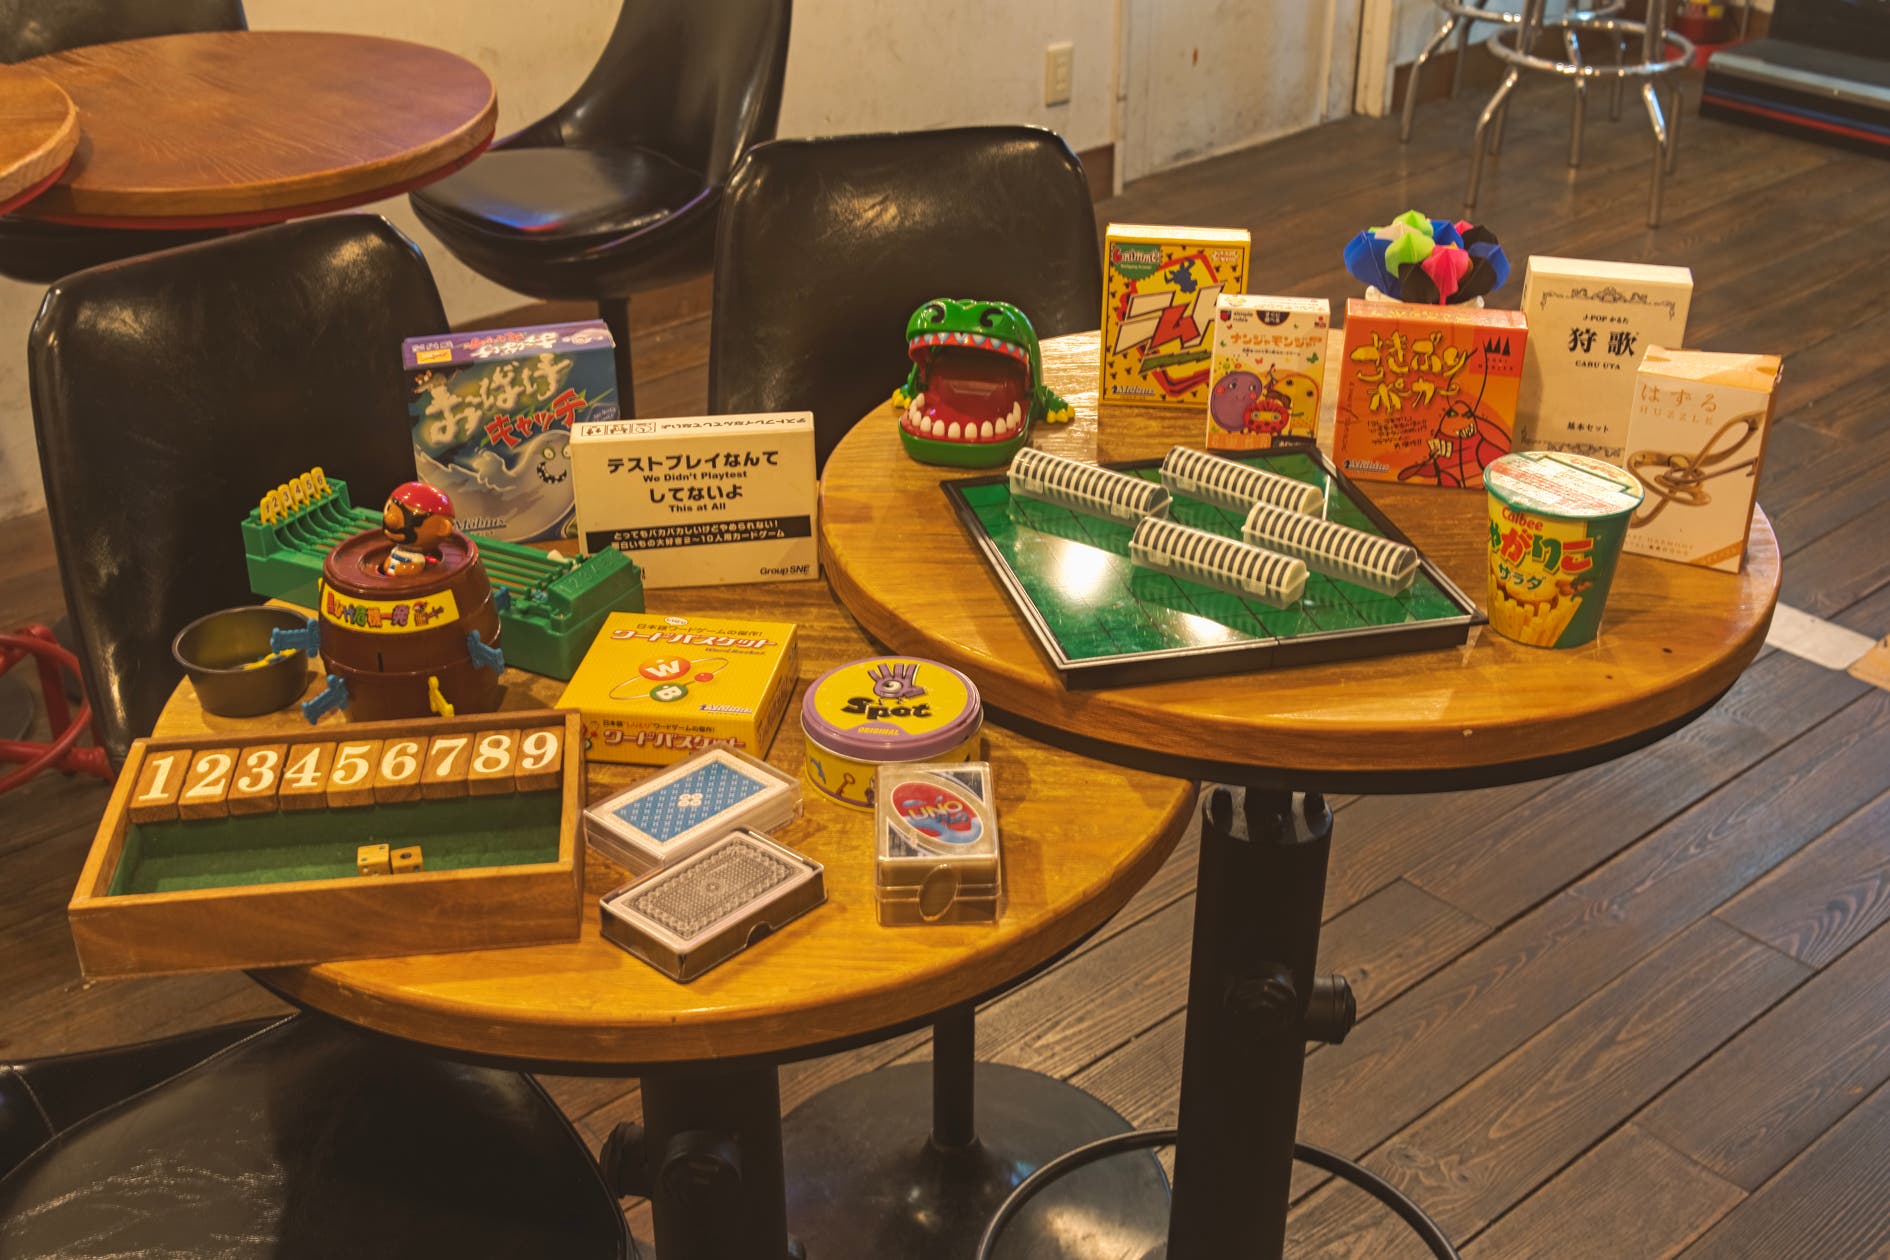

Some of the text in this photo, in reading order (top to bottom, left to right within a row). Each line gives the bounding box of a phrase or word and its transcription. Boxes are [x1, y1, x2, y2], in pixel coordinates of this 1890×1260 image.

[1567, 327, 1638, 357] 狩歌
[1602, 361, 1622, 371] UTA
[1640, 383, 1717, 413] はずる
[485, 387, 589, 449] キャッチ
[607, 450, 779, 475] テストプレイなんて
[643, 470, 748, 483] We Didn't Playtest
[649, 484, 743, 504] してないよ
[669, 502, 726, 513] This at All
[1501, 505, 1544, 531] Calbee
[760, 565, 810, 577] Group SNE
[1498, 562, 1547, 591] サラダ
[610, 629, 778, 649] ワードバスケット
[841, 696, 933, 720] Spot
[857, 726, 900, 737] ORIGINAL
[138, 731, 559, 800] 1 2 3 4 5 6 7 8 9
[907, 800, 963, 821] UNO
